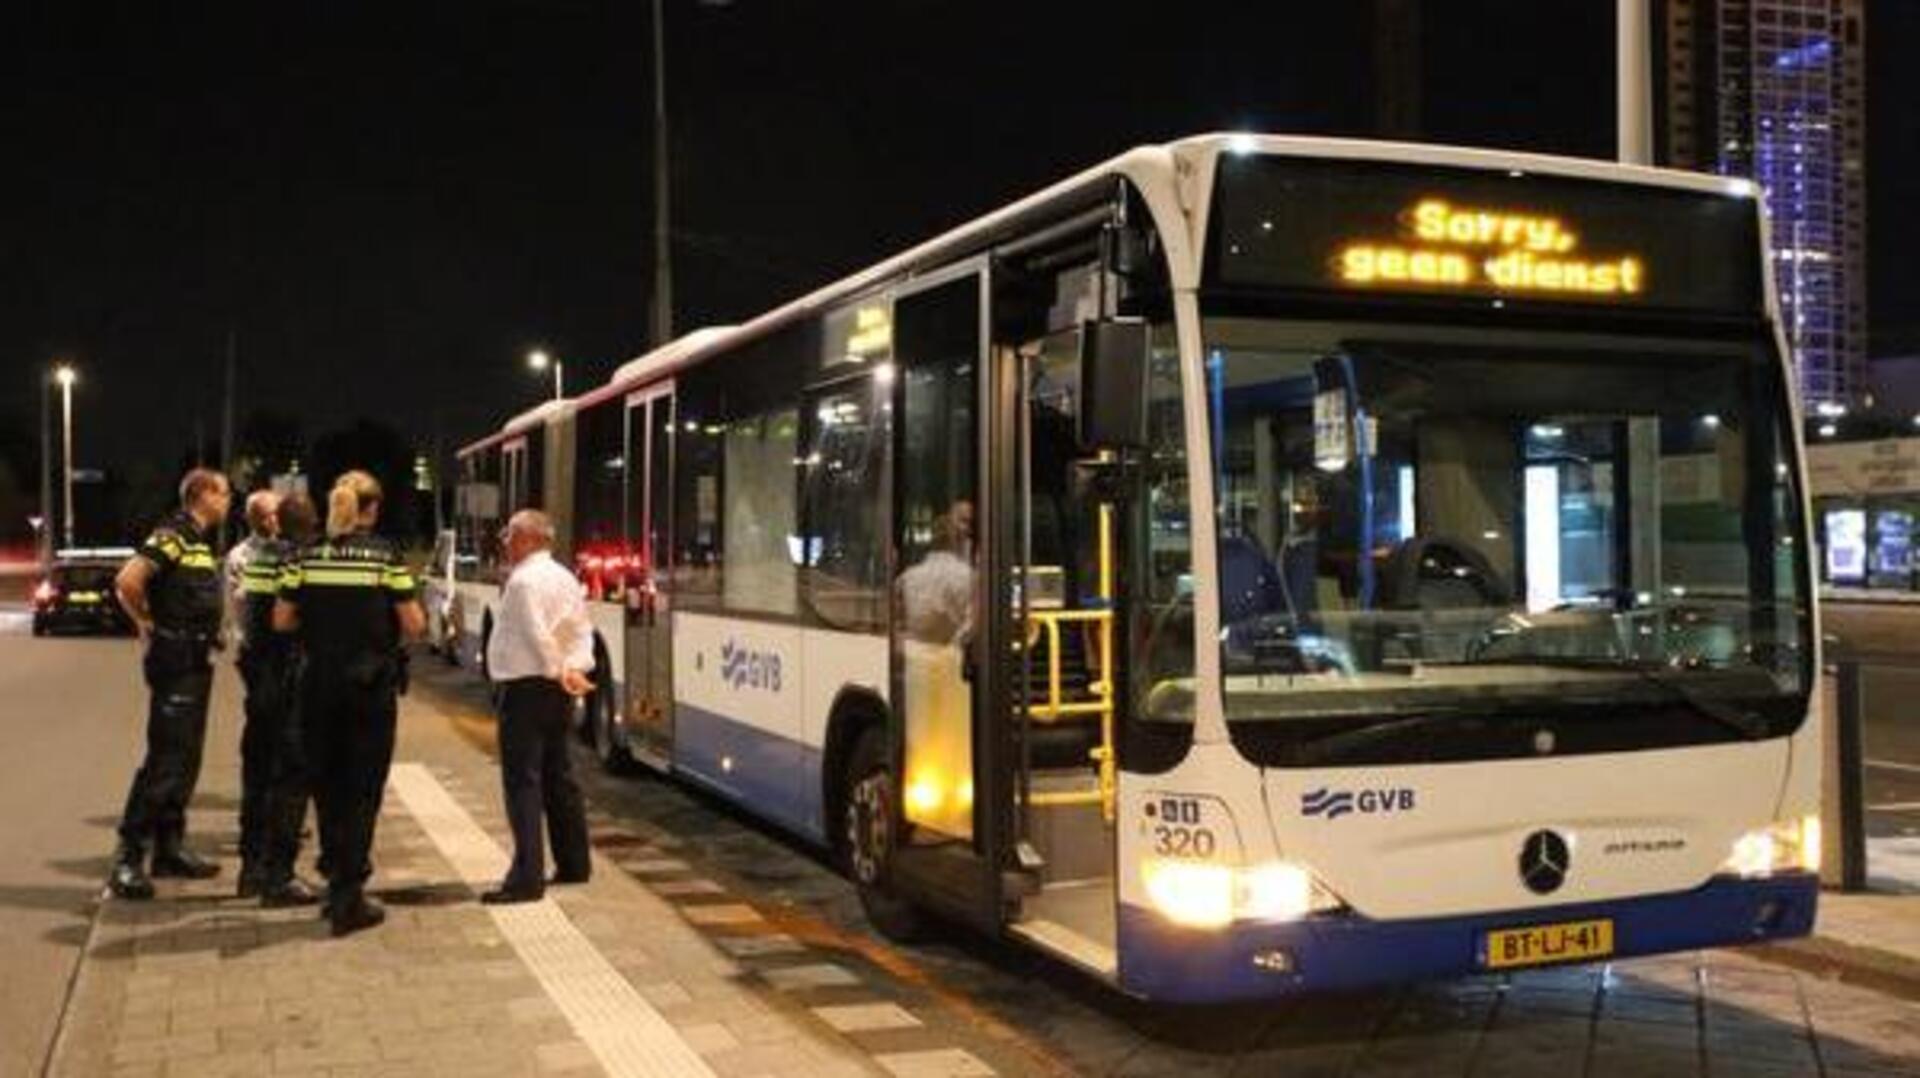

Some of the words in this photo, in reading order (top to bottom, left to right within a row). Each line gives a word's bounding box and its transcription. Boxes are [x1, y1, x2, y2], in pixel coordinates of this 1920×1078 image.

[1413, 199, 1577, 252] Sorry,
[1342, 246, 1470, 282] geen
[1488, 251, 1640, 292] dienst
[1357, 788, 1415, 813] GVB
[1154, 825, 1215, 858] 320
[1502, 923, 1600, 960] BT-LJ-41
